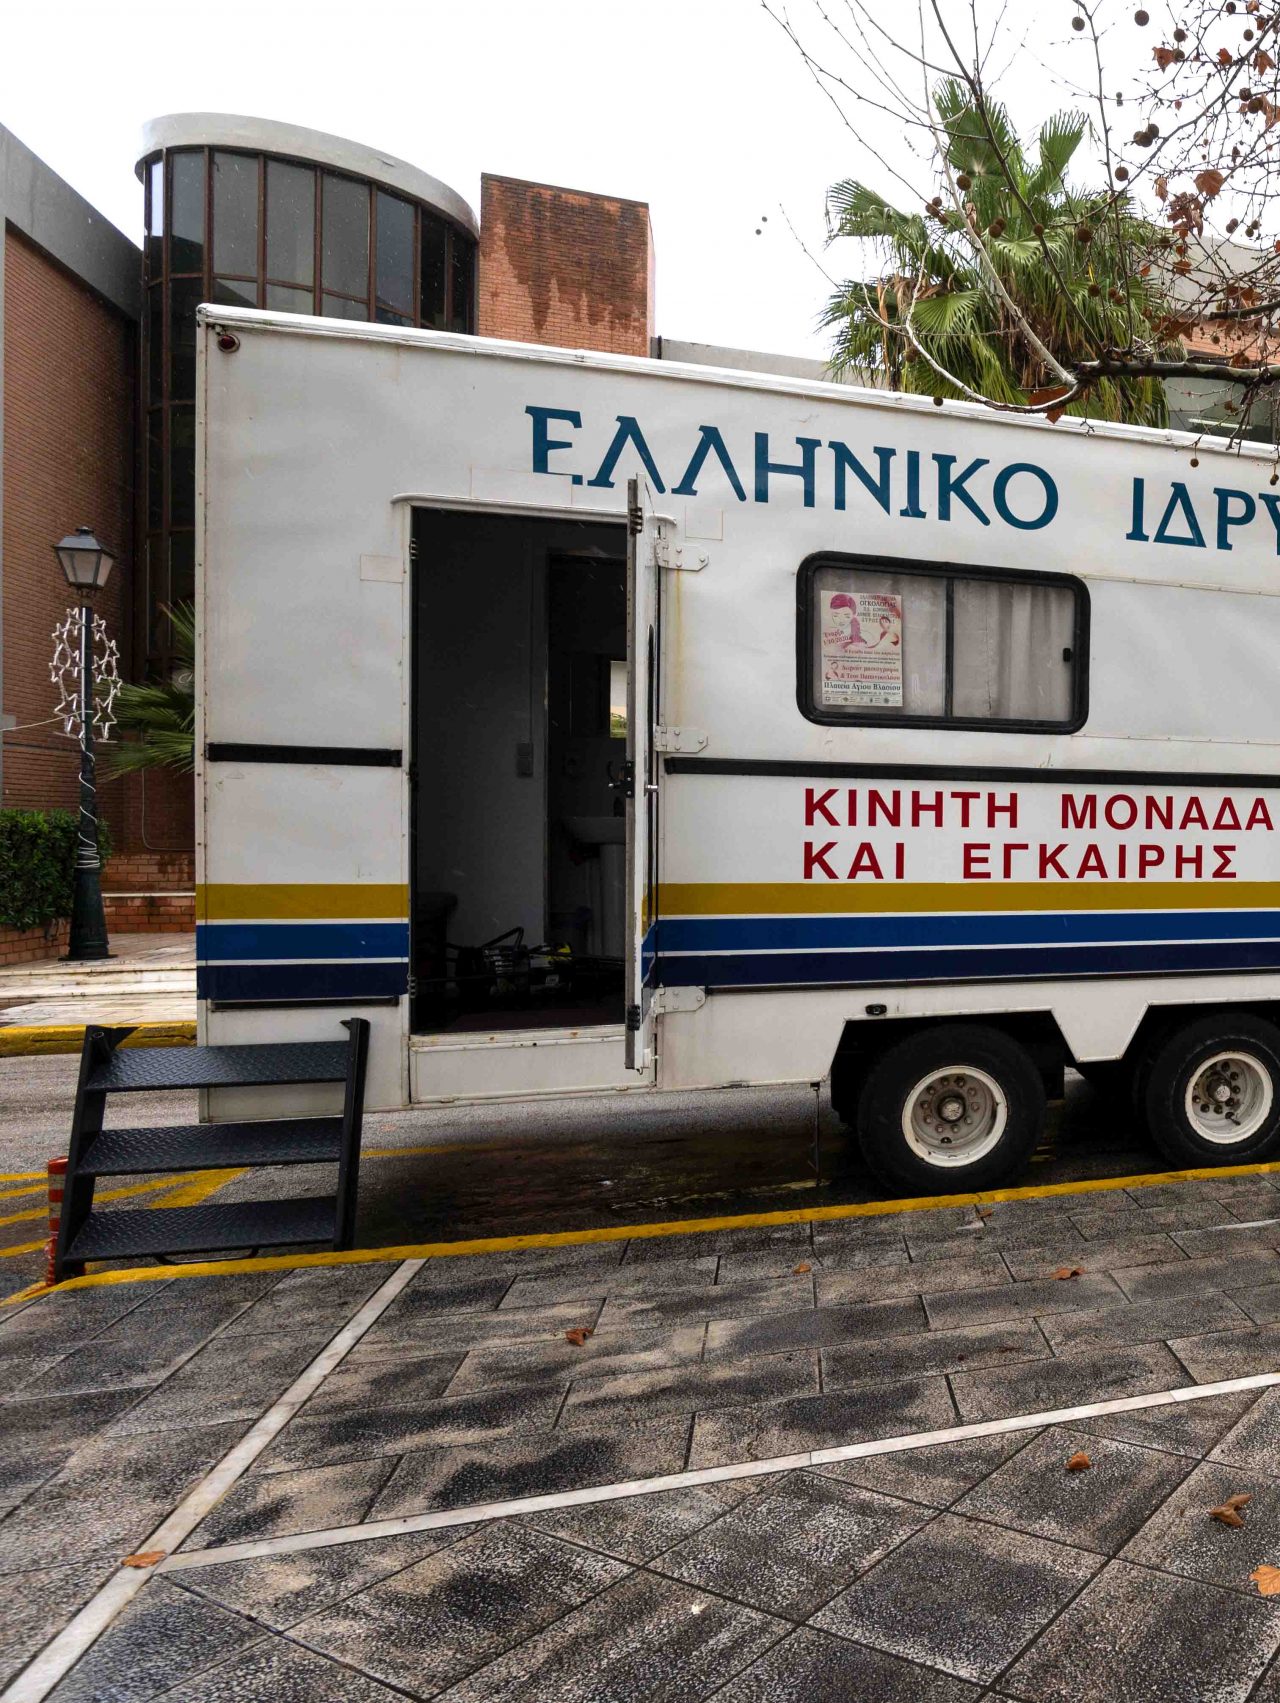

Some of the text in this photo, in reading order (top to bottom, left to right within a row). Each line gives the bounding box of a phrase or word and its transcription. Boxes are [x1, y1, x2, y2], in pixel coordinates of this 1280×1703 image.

[525, 405, 1059, 531] ΕΛΛΗΝΙΚΟ
[804, 788, 1018, 828] ΚΙΝΗΤΗ
[1061, 793, 1274, 831] ΜΟΝΑΔΑ
[803, 841, 905, 880] ΚΑΙ
[962, 842, 1237, 880] ΕΓΚΑΙΡΗΣ
